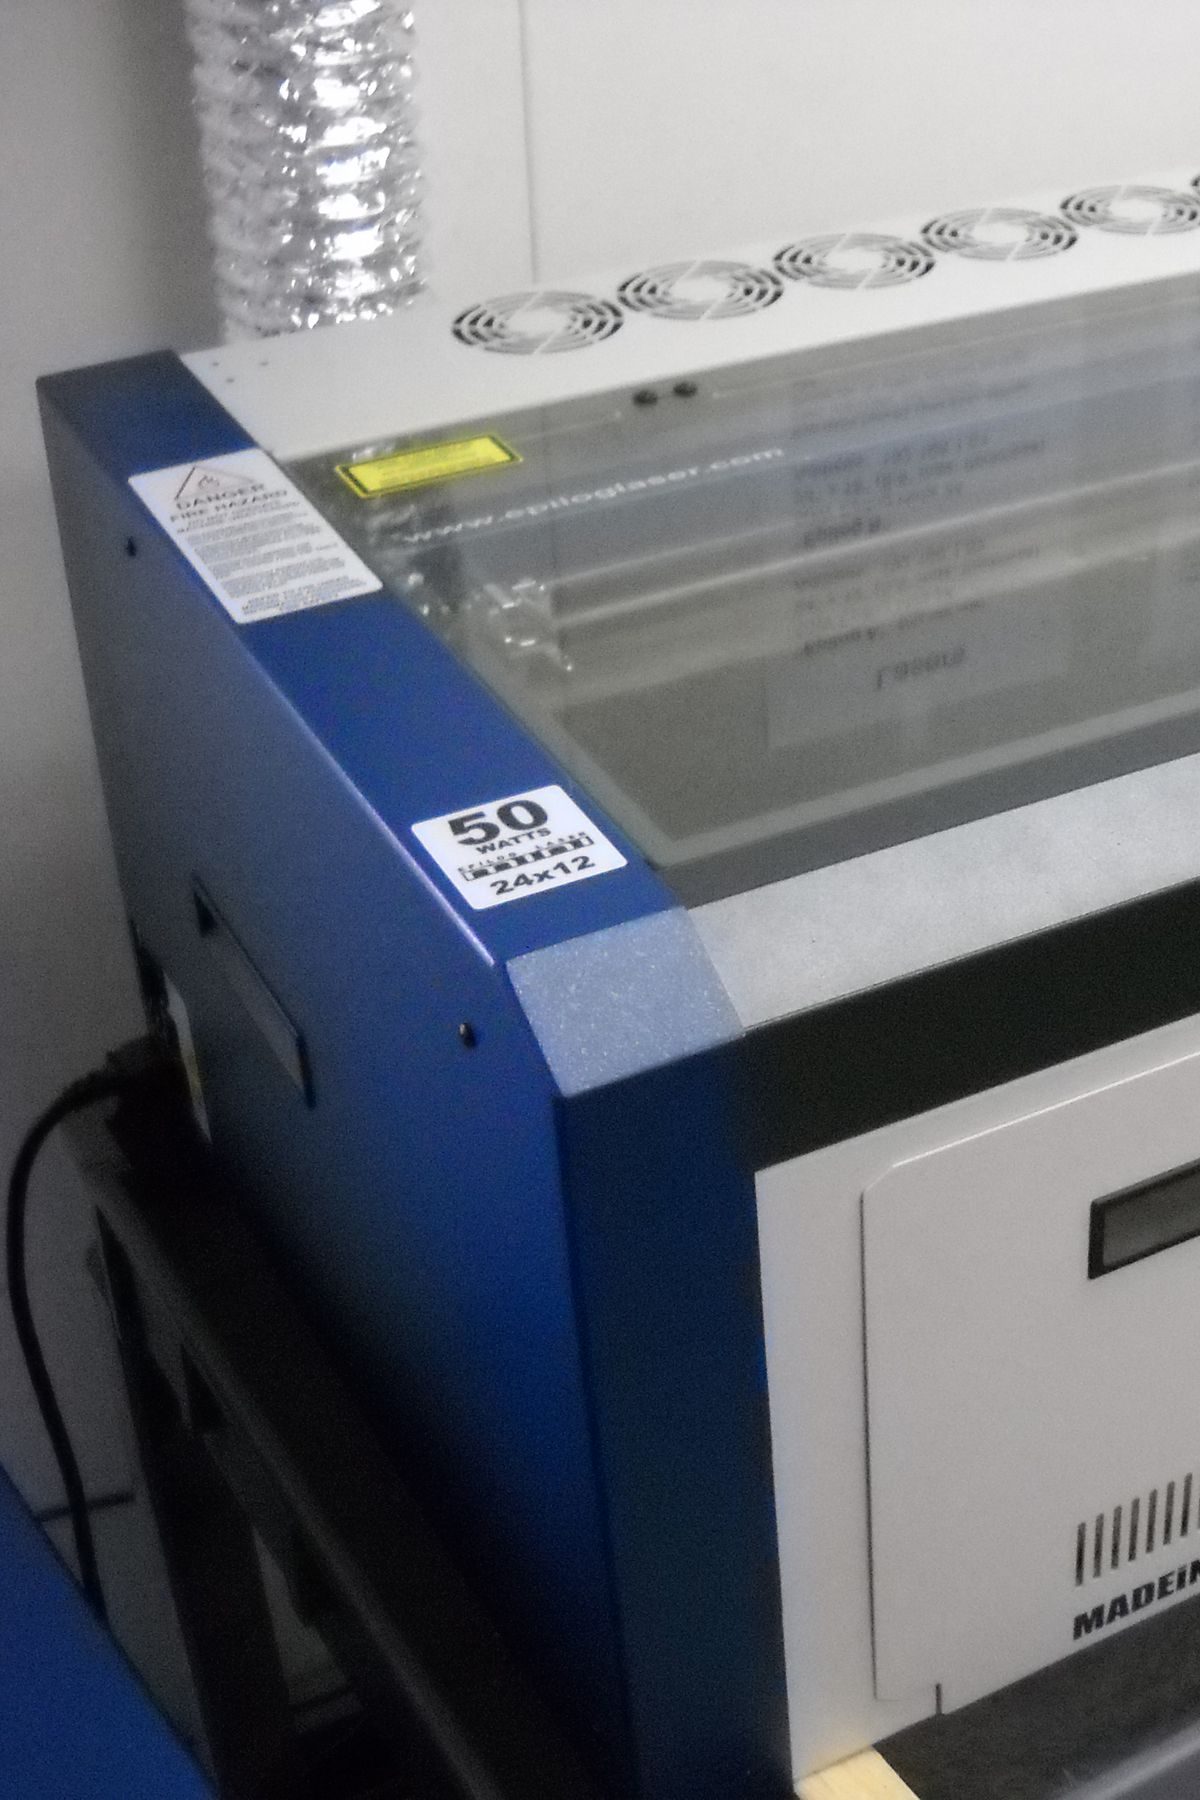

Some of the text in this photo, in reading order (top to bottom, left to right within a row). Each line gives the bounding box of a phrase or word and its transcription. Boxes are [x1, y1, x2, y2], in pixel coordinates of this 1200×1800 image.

[447, 799, 549, 846] 50
[475, 827, 552, 855] WATTS
[489, 855, 596, 896] 24x12
